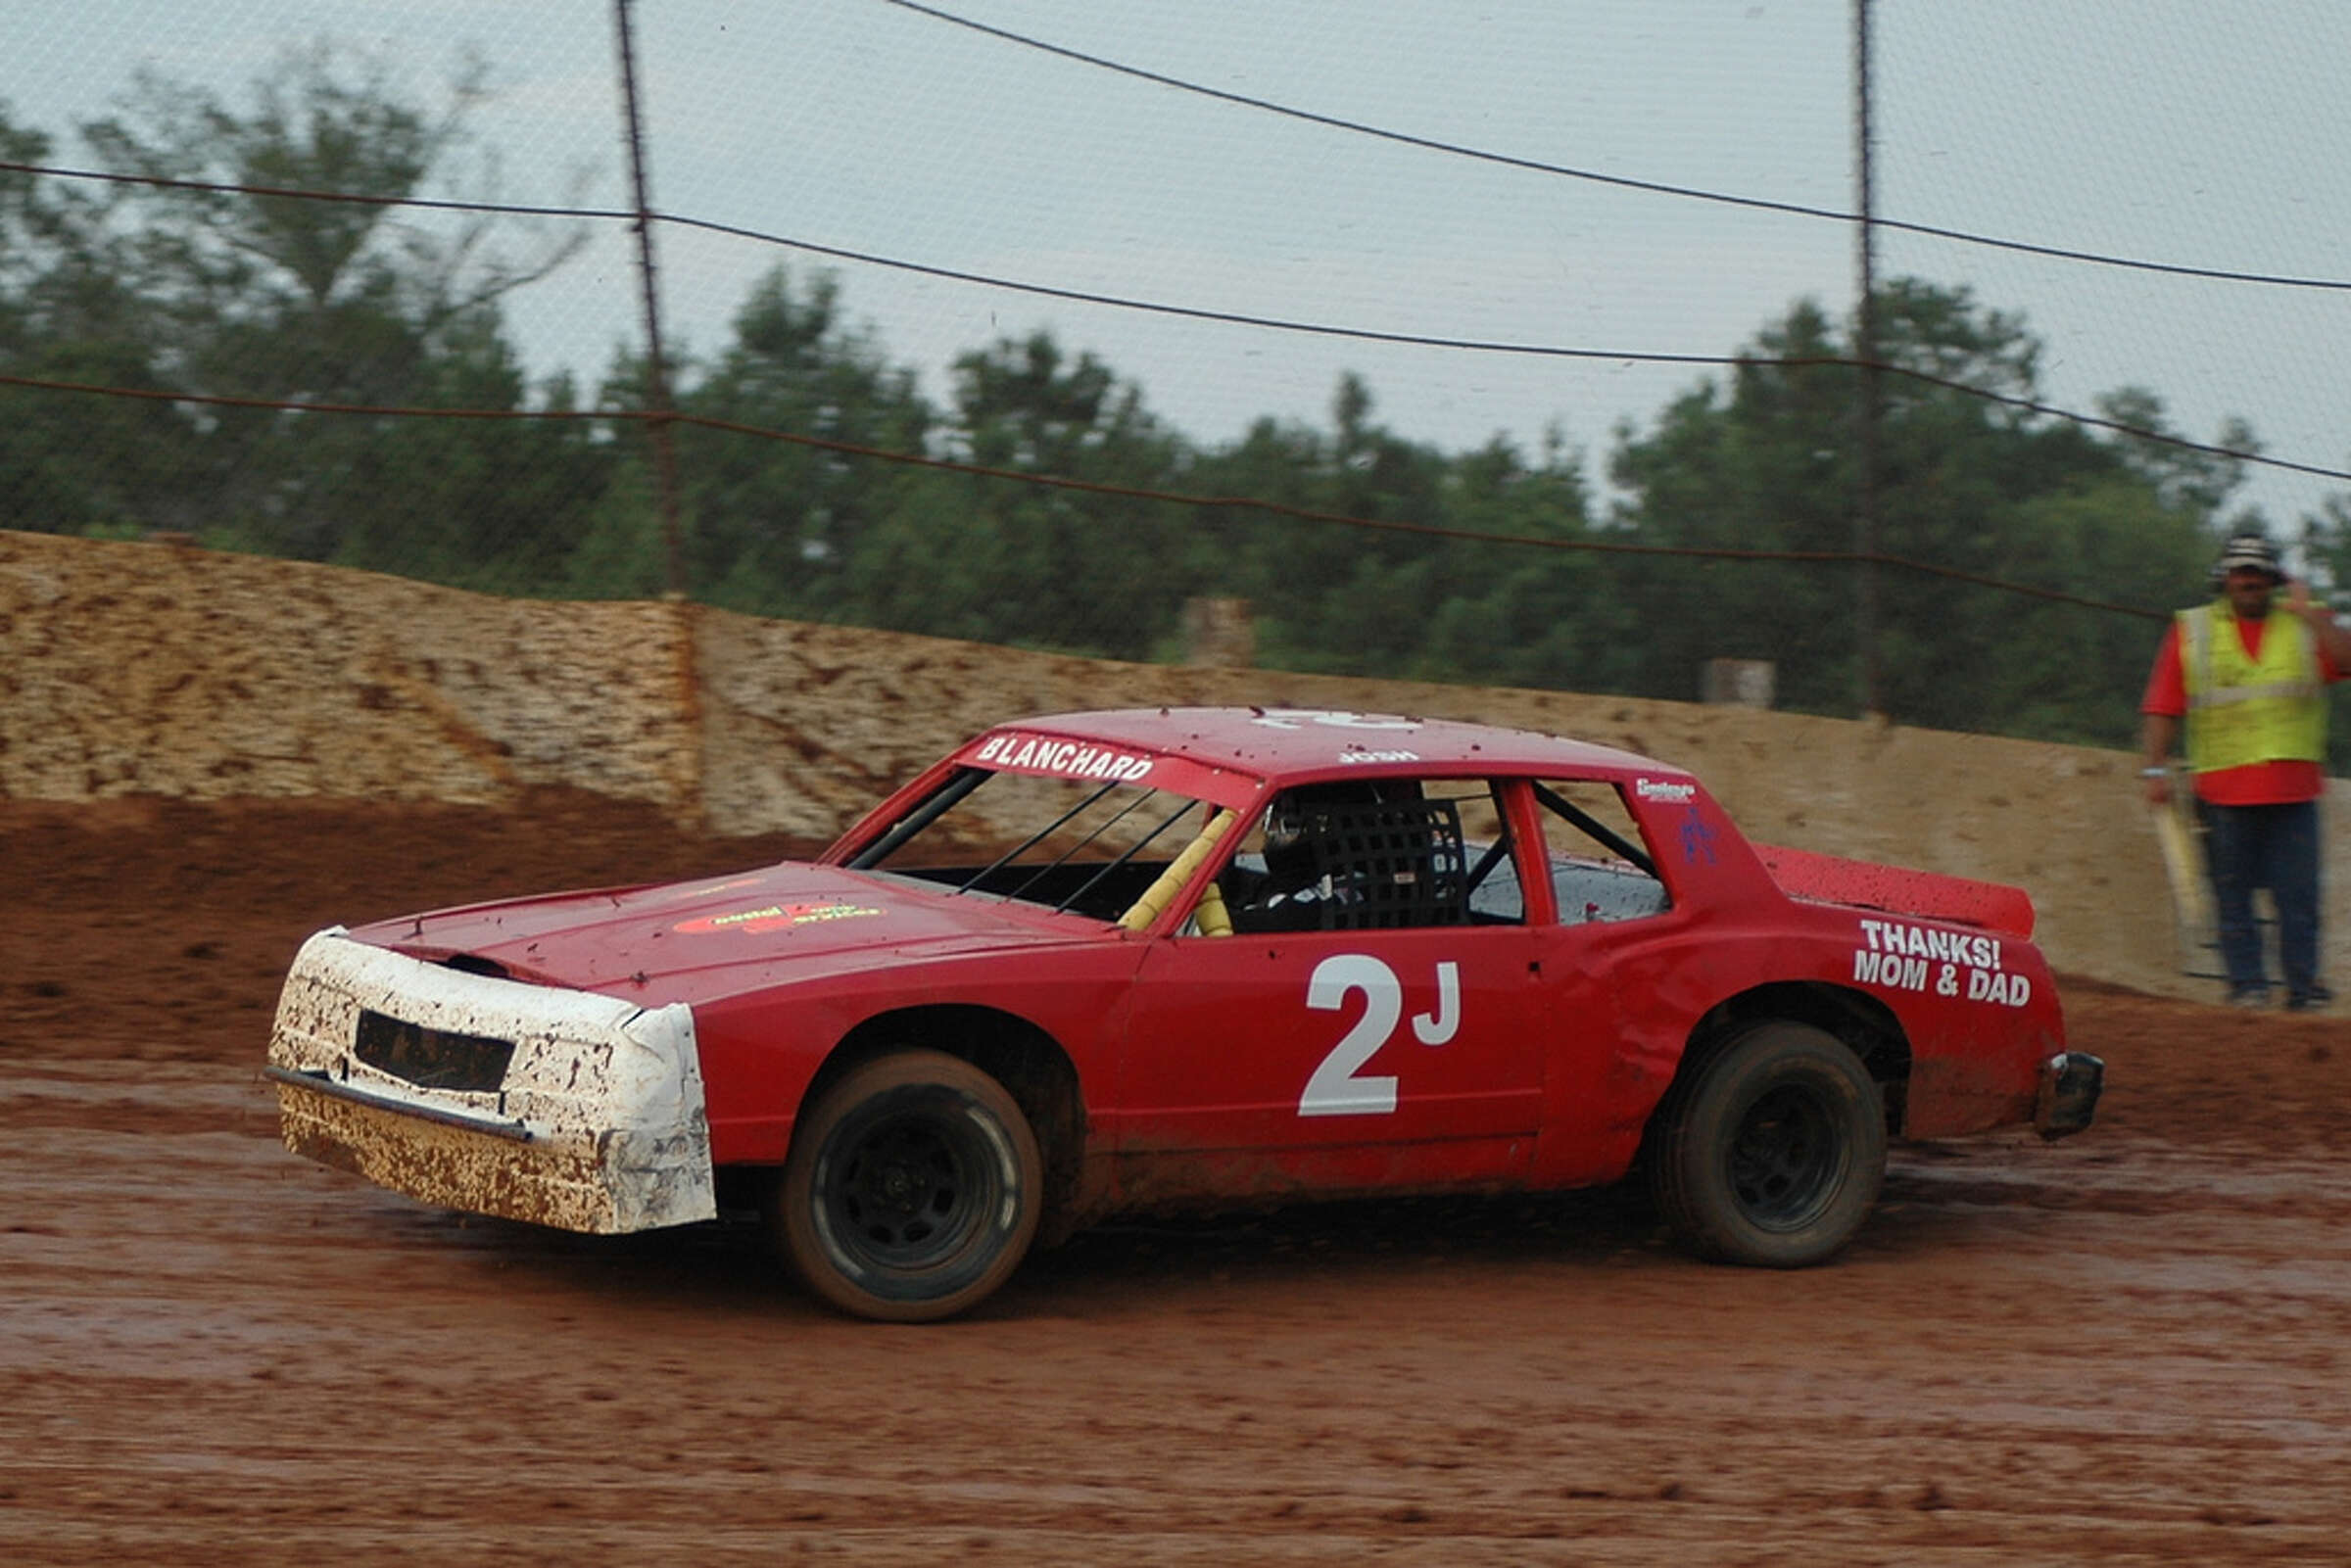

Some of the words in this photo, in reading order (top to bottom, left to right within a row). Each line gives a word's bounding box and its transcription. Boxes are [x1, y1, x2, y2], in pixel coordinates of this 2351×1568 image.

[977, 737, 1153, 781] BLANCHARD
[1860, 920, 2001, 971] THANKS!
[1852, 950, 1929, 991] MOM
[1936, 964, 1958, 997] &
[1967, 970, 2031, 1007] DAD
